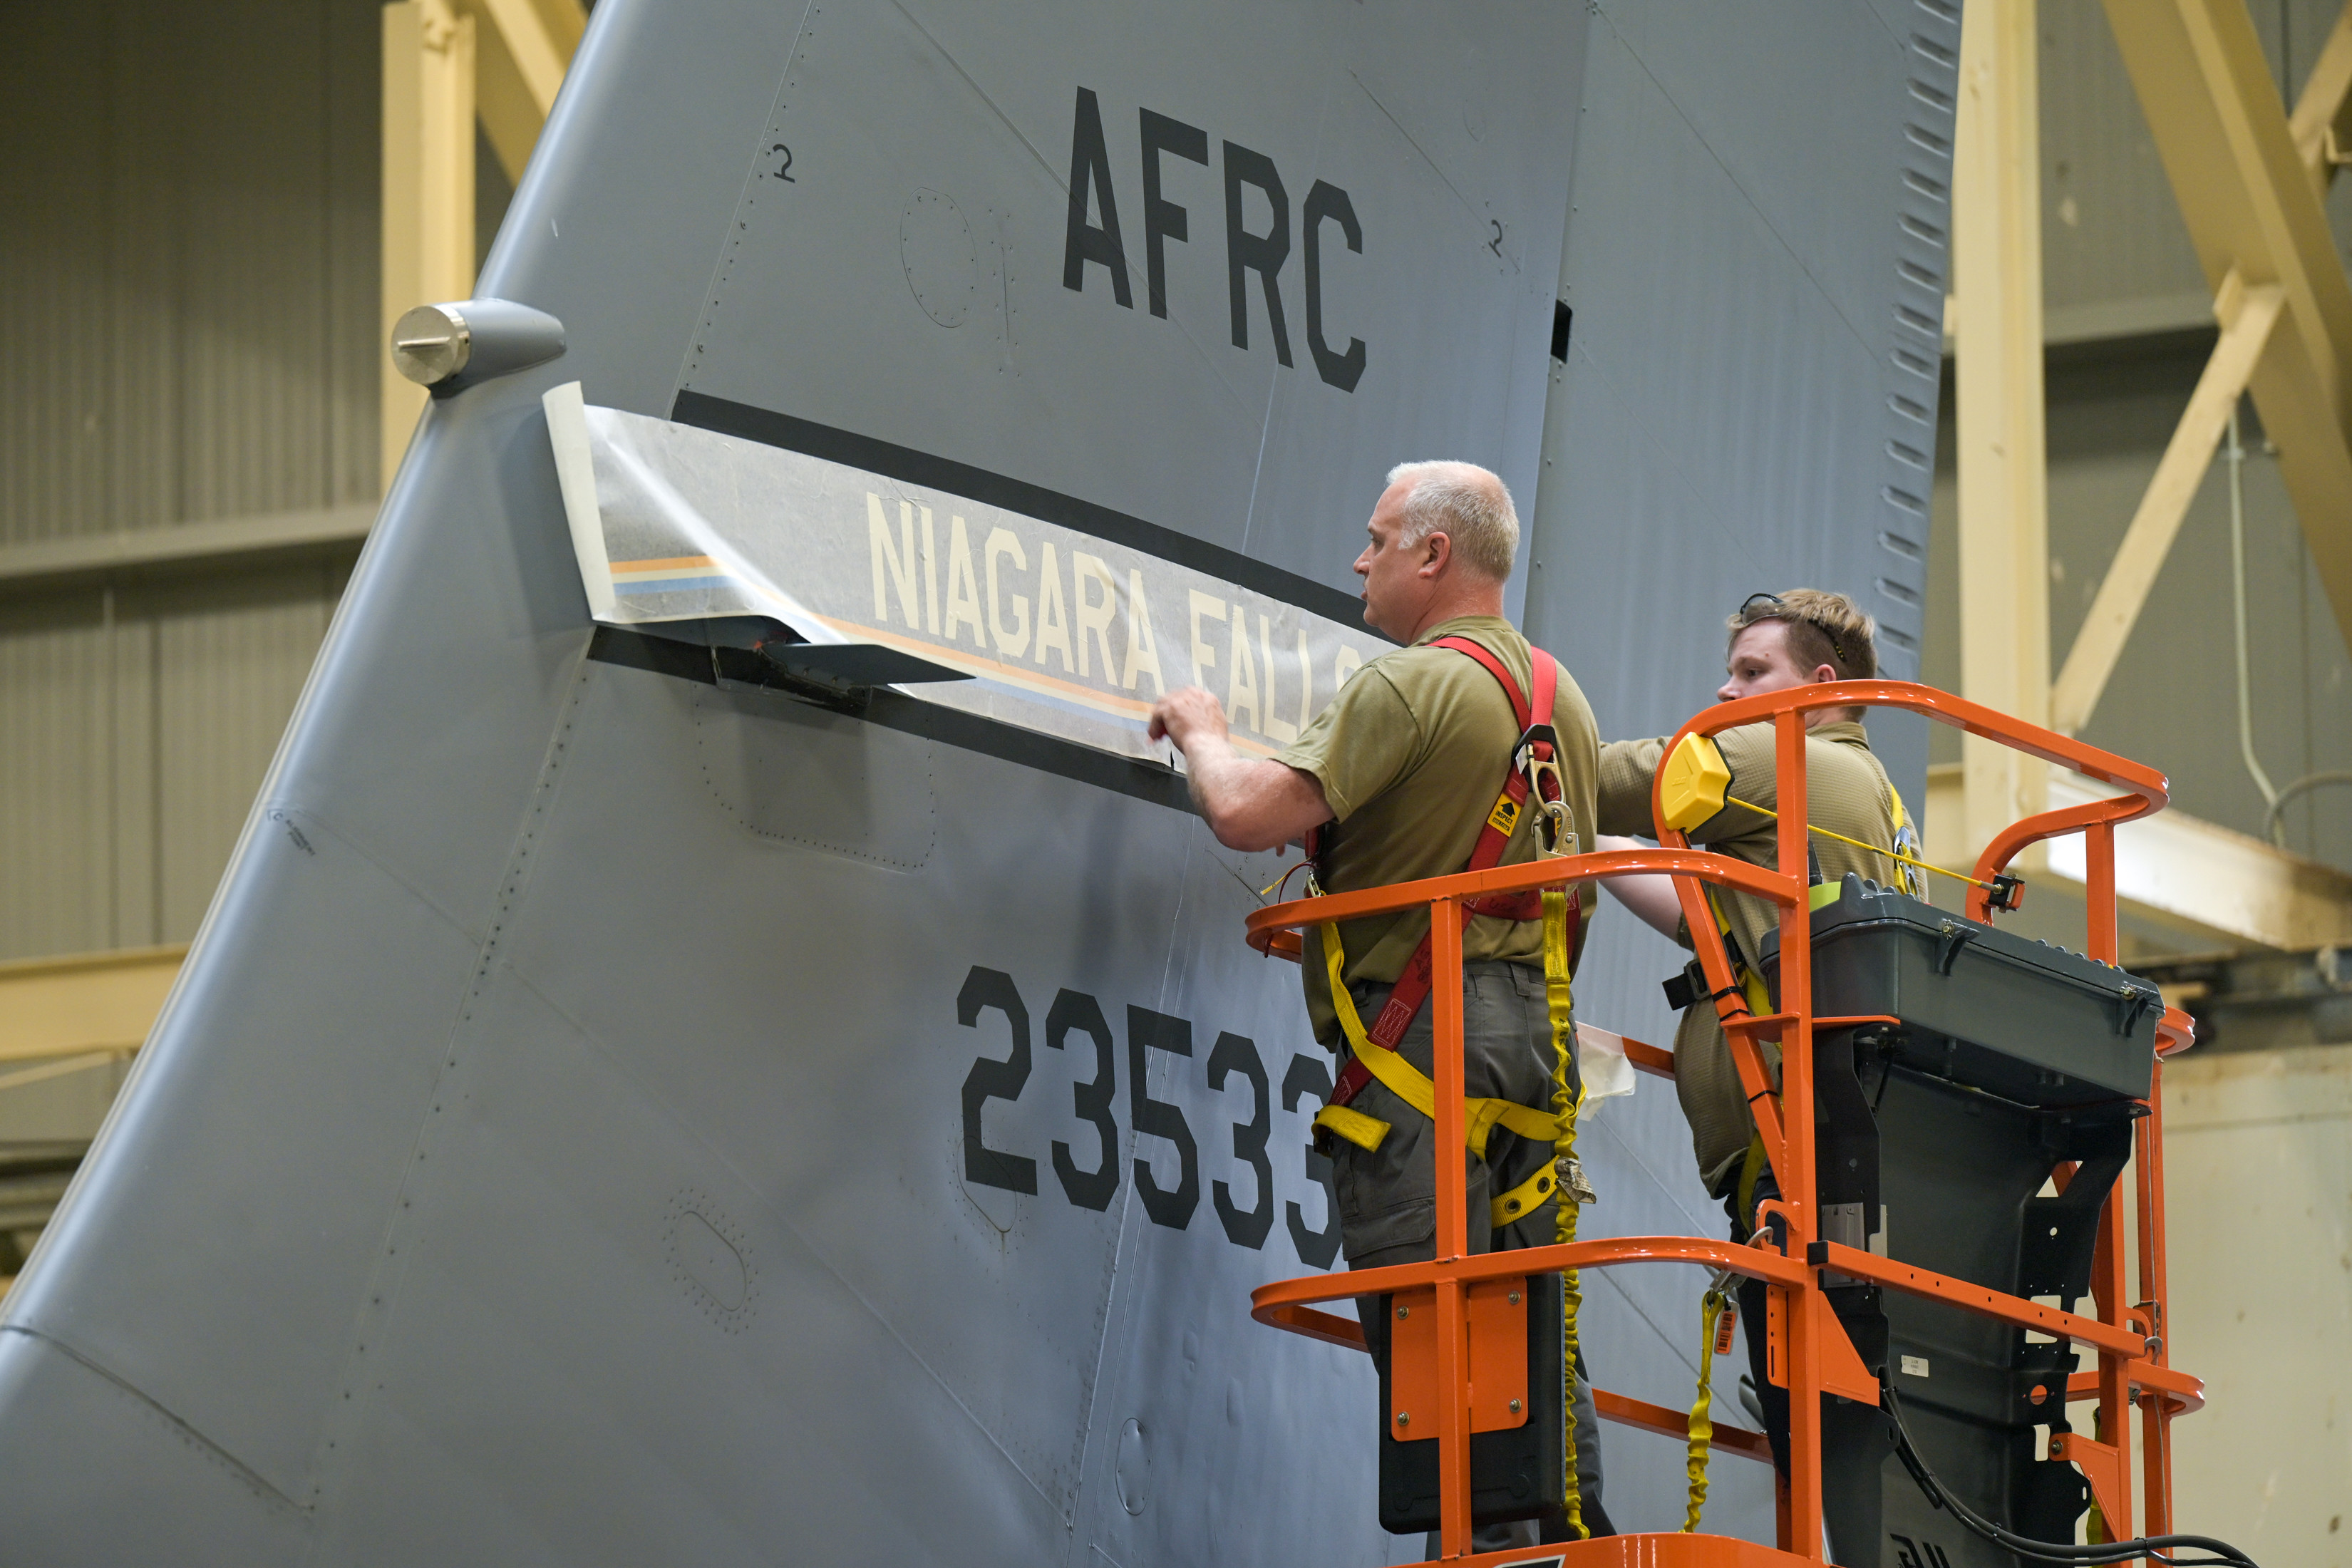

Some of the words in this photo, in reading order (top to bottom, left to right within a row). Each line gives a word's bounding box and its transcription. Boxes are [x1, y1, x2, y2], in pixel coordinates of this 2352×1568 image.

[773, 144, 795, 183] 2
[1063, 86, 1366, 394] AFRC
[1488, 220, 1502, 258] 2
[867, 492, 1165, 696] NIAGARA
[1496, 810, 1514, 825] INSPECT
[956, 964, 1343, 1271] 23533
